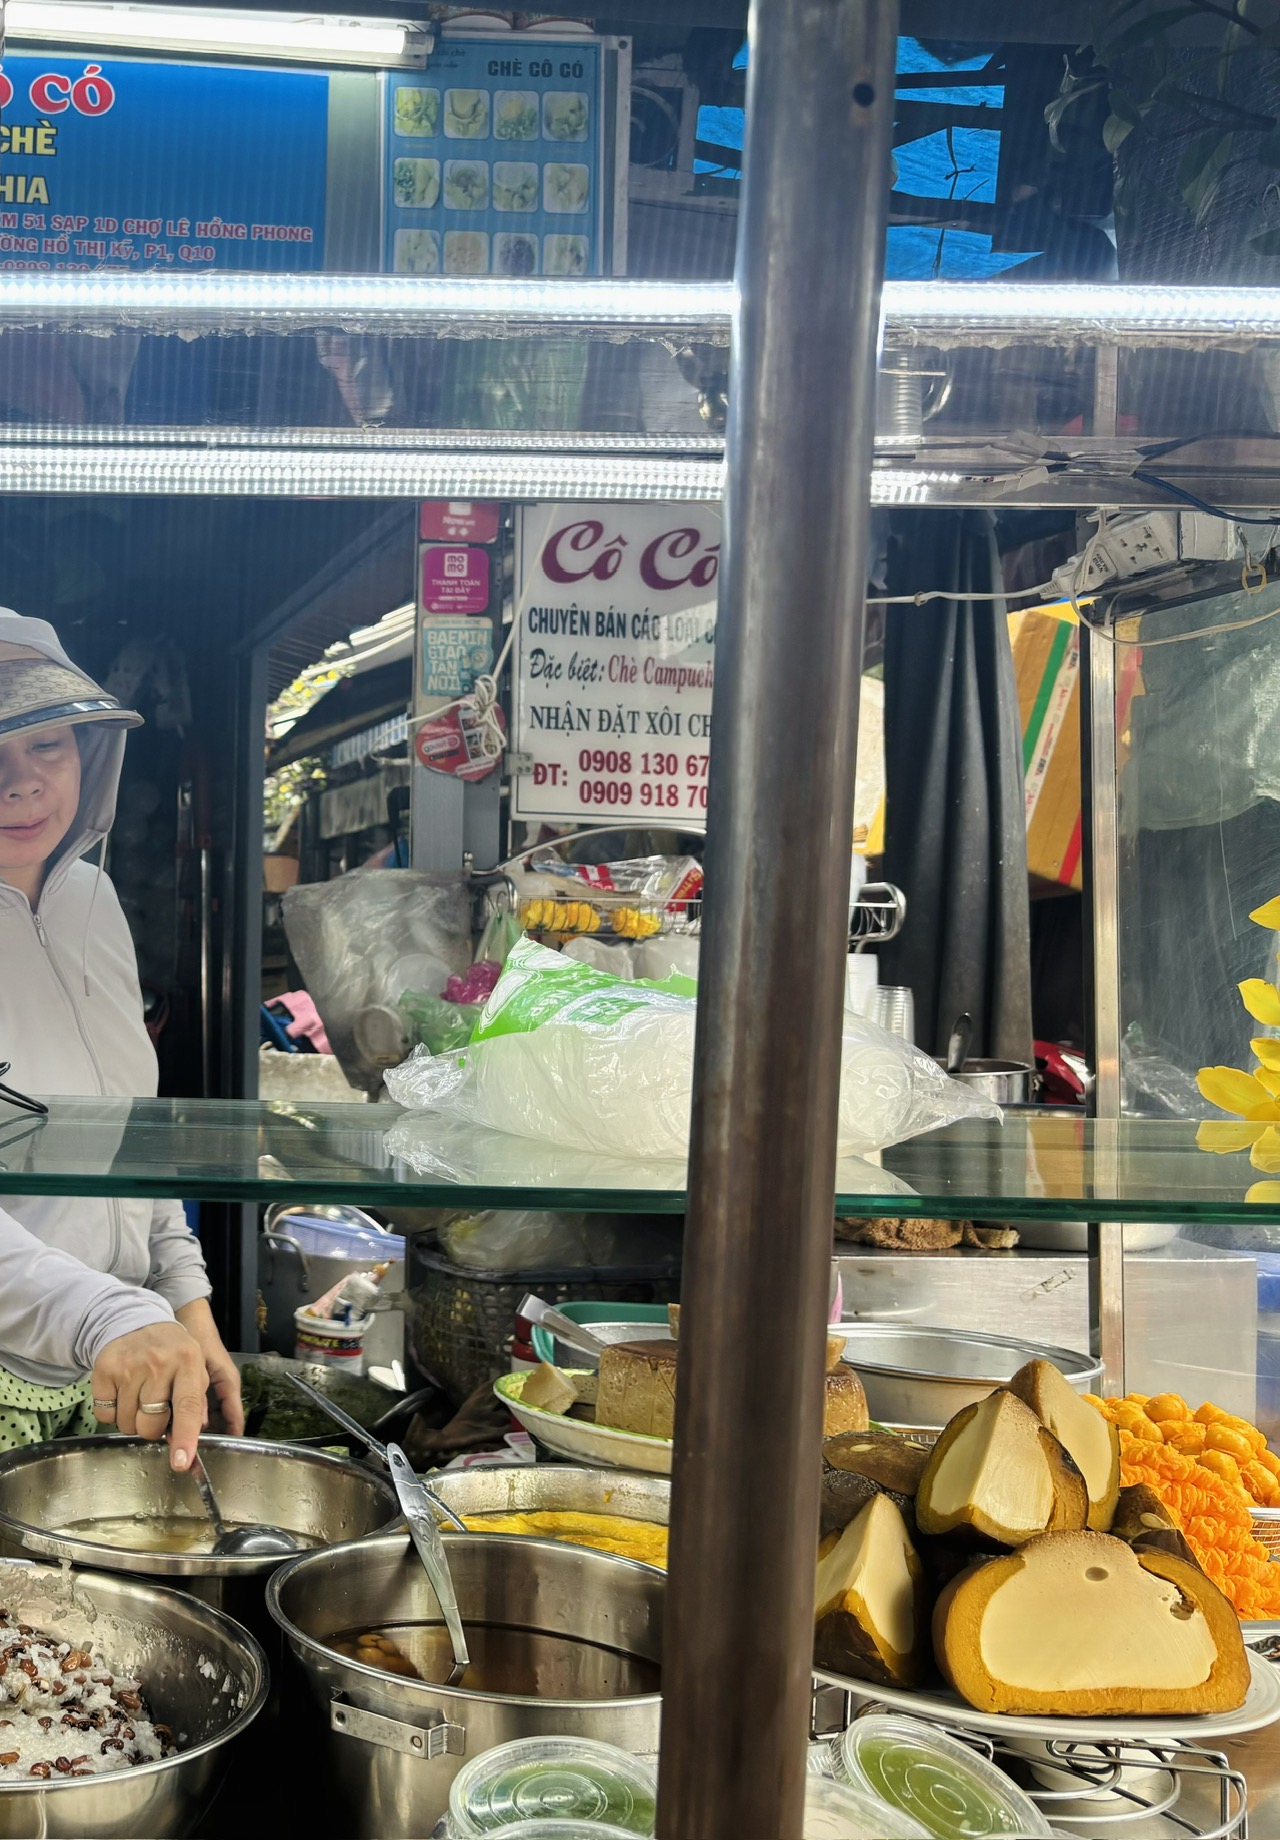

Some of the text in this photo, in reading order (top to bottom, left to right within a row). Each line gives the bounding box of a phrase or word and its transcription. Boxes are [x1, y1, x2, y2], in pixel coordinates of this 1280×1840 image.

[487, 58, 584, 79] CHÈ CÔ CÓ
[29, 64, 116, 117] CÓ
[23, 214, 46, 230] 51
[51, 215, 89, 234] SẠP
[94, 217, 118, 232] 1D
[123, 218, 163, 239] CHỢ
[166, 217, 190, 237] LÊ
[196, 216, 247, 240] HỒNG
[251, 223, 314, 242] PHONG
[44, 233, 69, 254] HỒ
[74, 240, 105, 260] THỊ
[144, 244, 174, 262] P1,
[179, 245, 216, 263] Q10
[541, 520, 720, 590] Cô Có
[528, 602, 590, 636] CHUYÊN
[595, 605, 626, 639] BÁN
[631, 607, 661, 640] CÁC
[427, 630, 488, 645] BAEMIN
[530, 647, 714, 694] Đặc biệt: Chè Campuch
[529, 700, 713, 739] NHẬN ĐẶT XÔI CH
[532, 762, 569, 787] ĐT:
[578, 749, 711, 778] 0908 130 67
[579, 780, 709, 808] 0909 918 70
